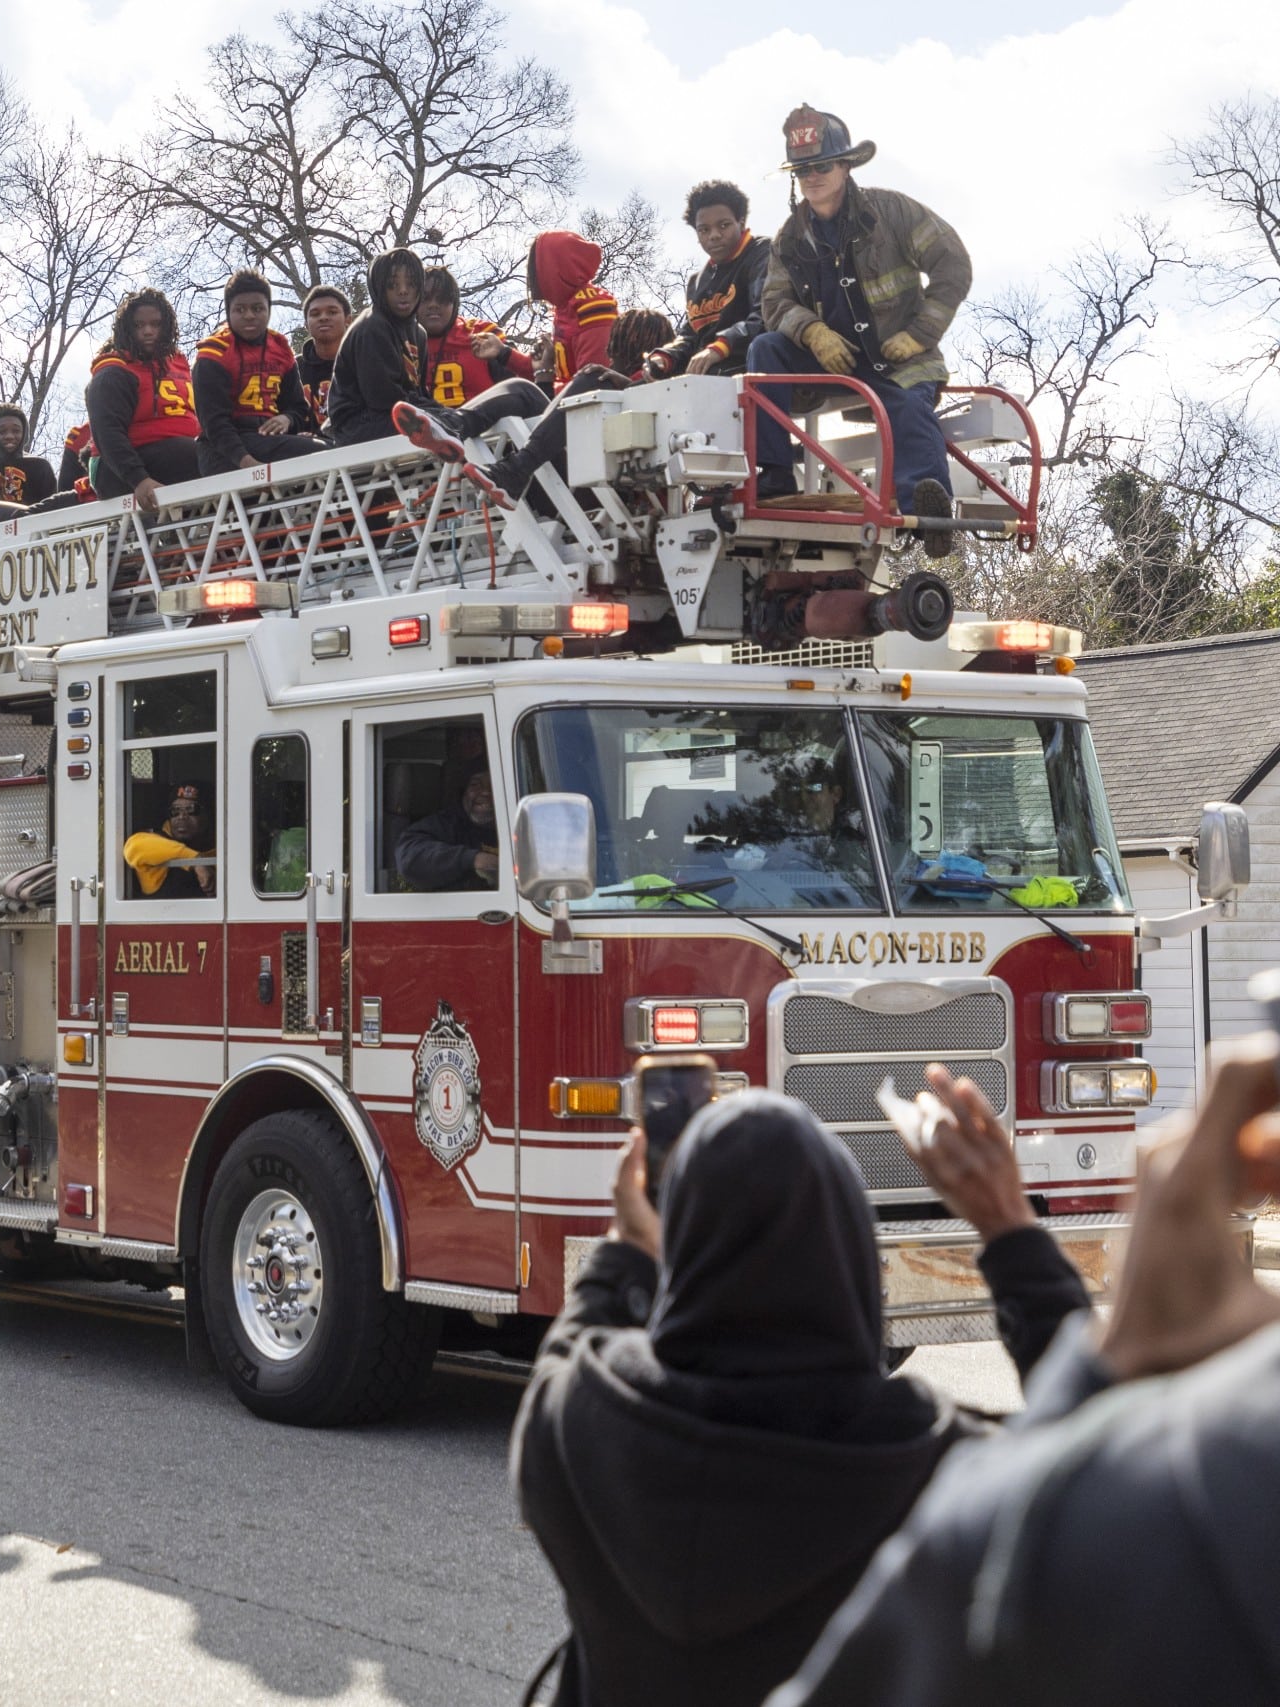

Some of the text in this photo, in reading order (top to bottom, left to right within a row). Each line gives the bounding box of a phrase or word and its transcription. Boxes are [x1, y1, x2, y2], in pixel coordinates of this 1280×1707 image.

[433, 362, 466, 408] 8
[251, 469, 266, 481] 105
[114, 941, 208, 974] AERIAL 7
[798, 930, 988, 967] MACON-BIBB
[443, 1085, 452, 1110] 1
[425, 1115, 442, 1144] FIRE
